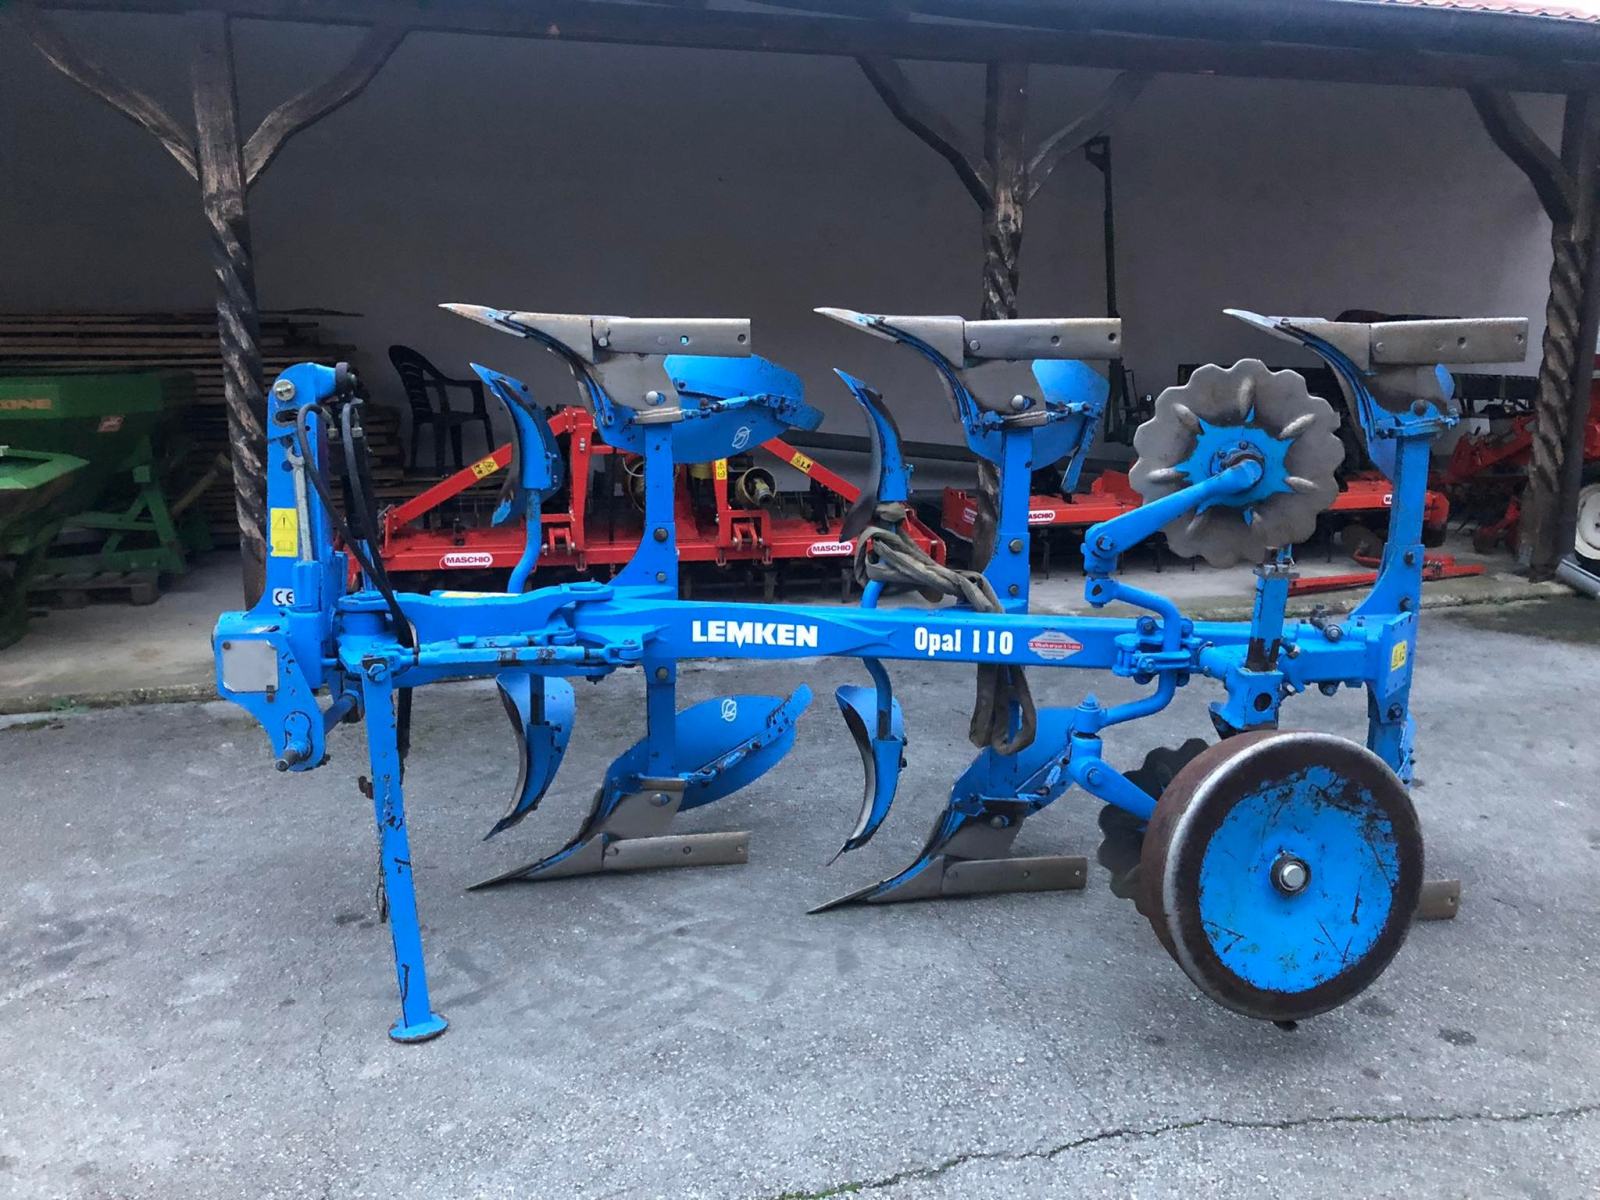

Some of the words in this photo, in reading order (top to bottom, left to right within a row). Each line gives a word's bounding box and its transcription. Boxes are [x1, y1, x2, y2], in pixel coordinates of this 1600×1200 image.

[812, 544, 851, 552] MASCHIO
[446, 556, 490, 564] MASCHIO
[692, 620, 818, 649] LEMKEN
[914, 626, 961, 656] Opal
[972, 629, 1014, 655] 110
